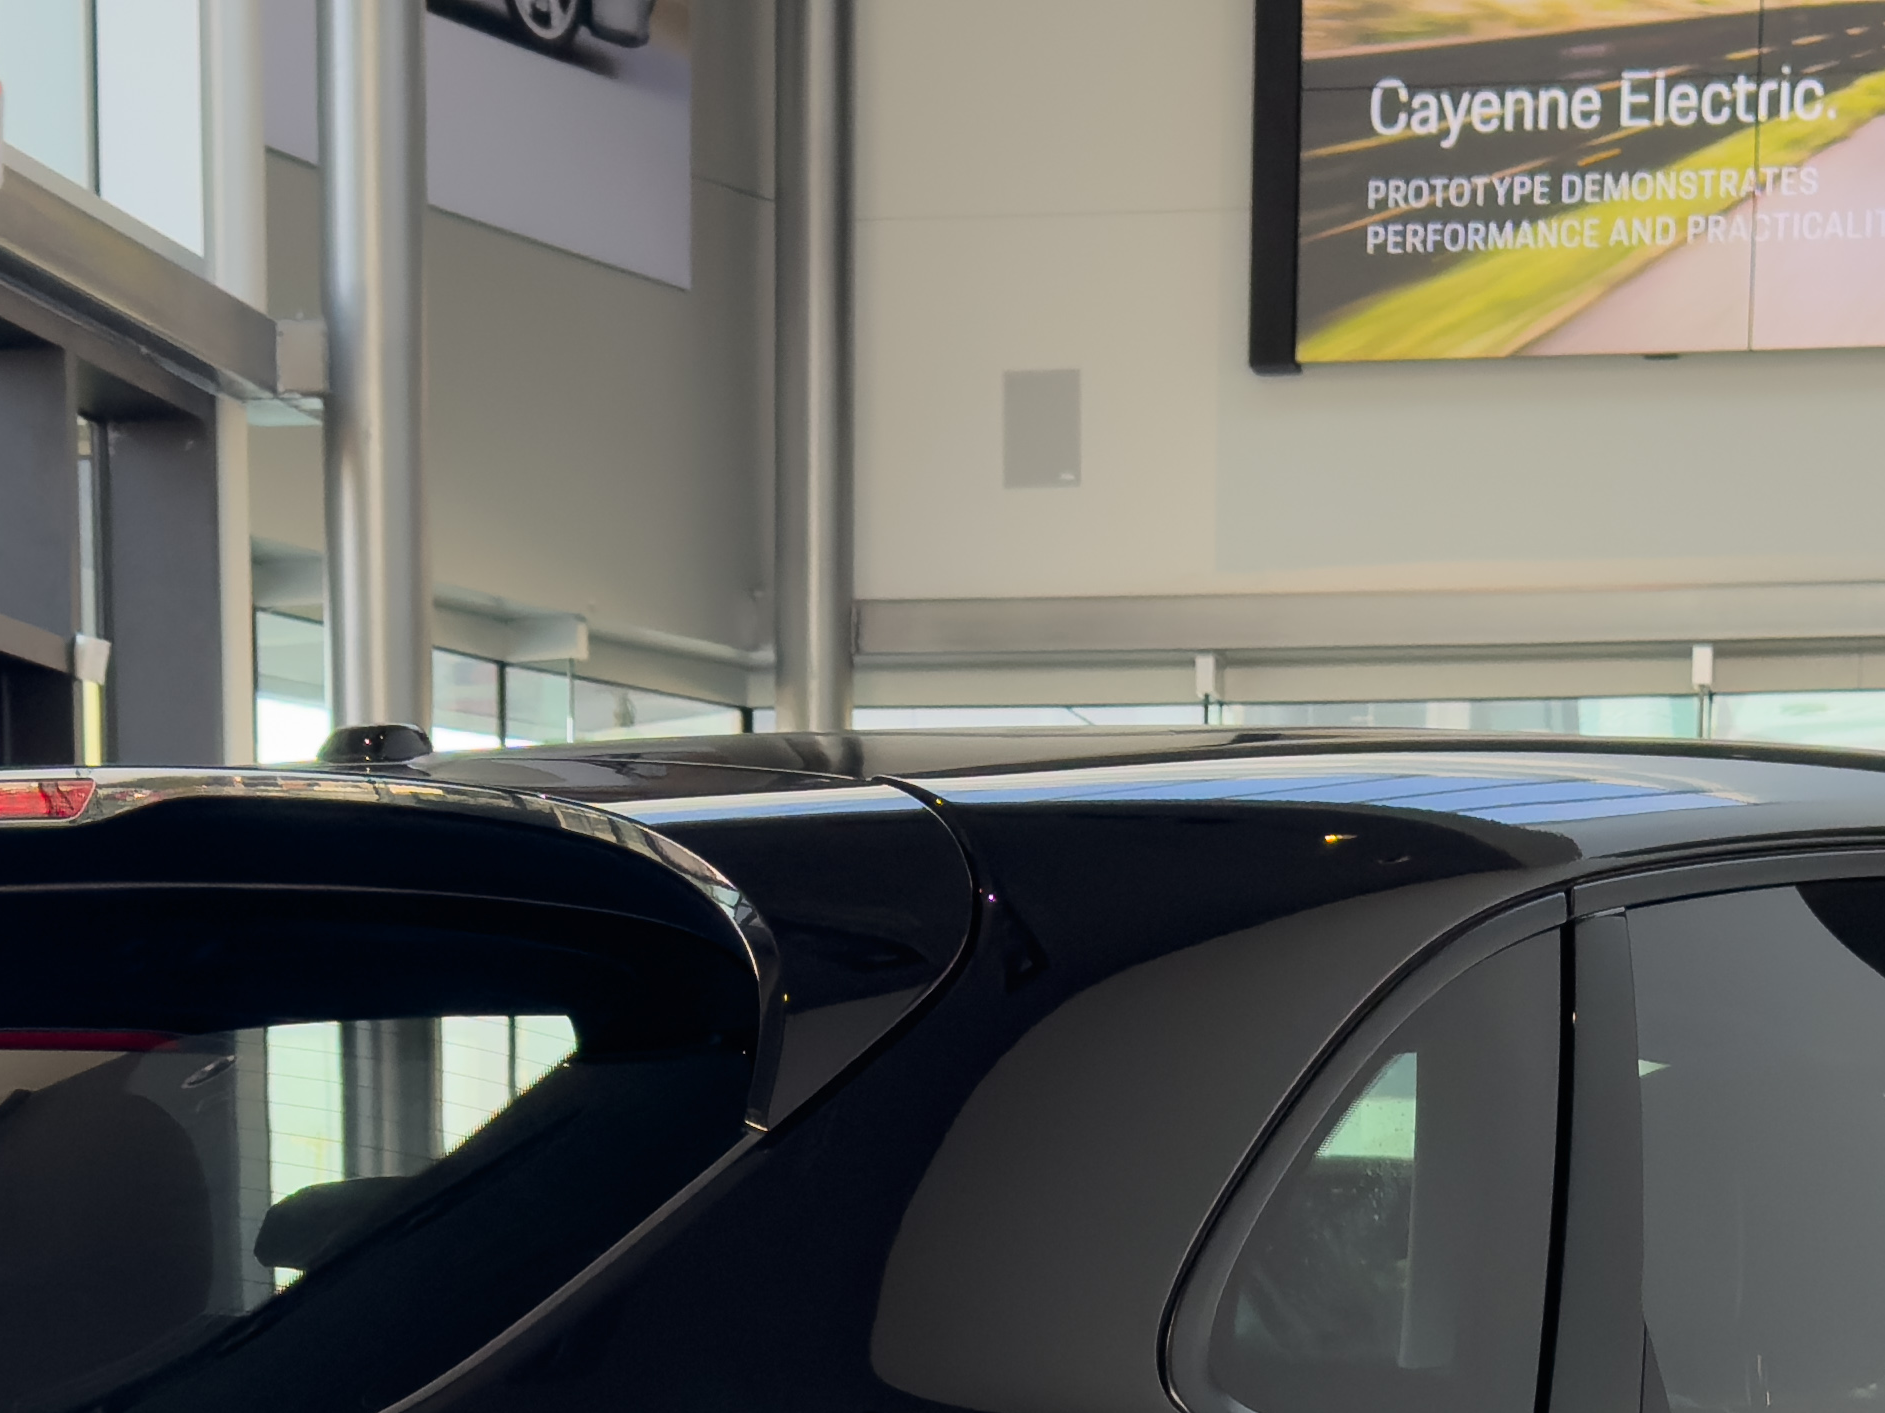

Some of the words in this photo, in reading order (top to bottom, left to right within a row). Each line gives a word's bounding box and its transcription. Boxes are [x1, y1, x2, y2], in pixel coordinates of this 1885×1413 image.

[1369, 76, 1604, 150] Cayenne
[1618, 64, 1839, 128] Electric.
[1366, 174, 1552, 209] PROTOTYPE
[1560, 166, 1819, 204] DEMONSTRATES
[1366, 217, 1601, 254] PERFORMANCE
[1609, 214, 1678, 247] AND
